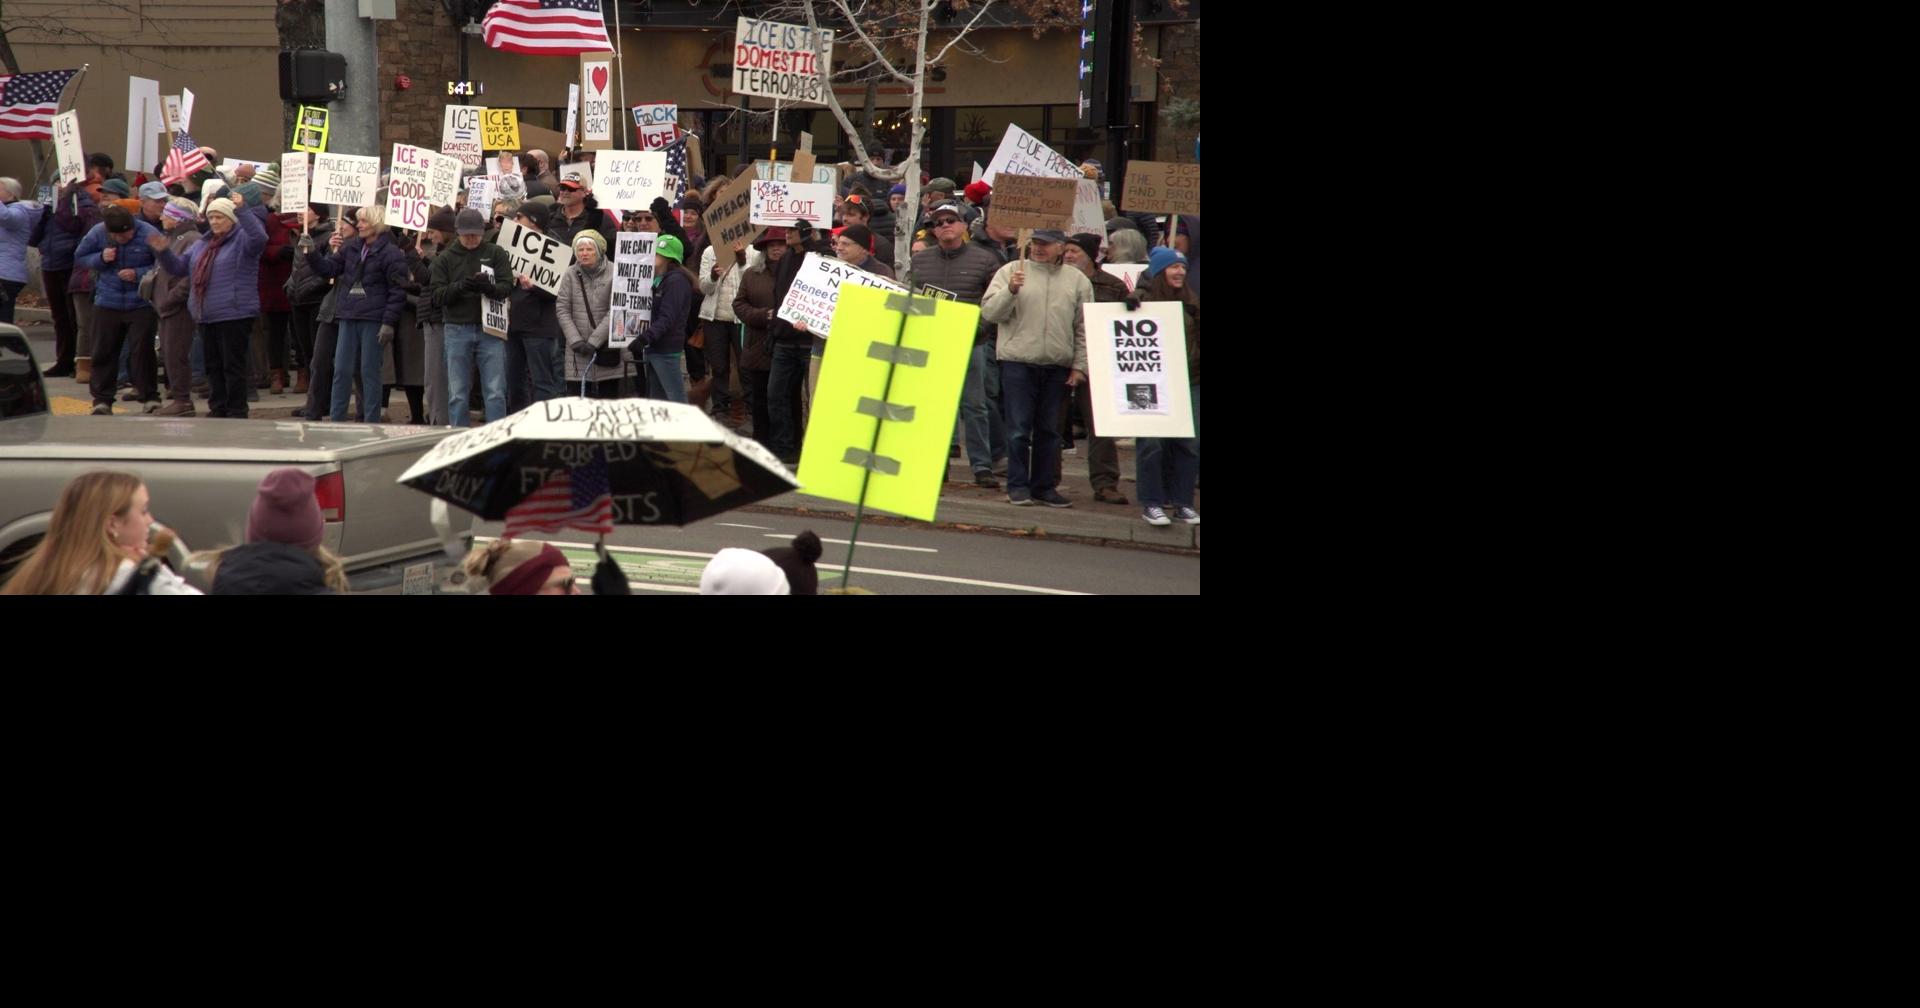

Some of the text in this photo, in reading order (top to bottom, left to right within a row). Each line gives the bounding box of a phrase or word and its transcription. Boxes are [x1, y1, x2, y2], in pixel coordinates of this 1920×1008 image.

[743, 20, 831, 52] ICE IS TE
[736, 44, 817, 74] DOMESTIC
[586, 100, 608, 116] DEMO
[452, 109, 478, 130] ICE
[485, 111, 510, 126] ICE
[585, 118, 609, 133] CRACY
[443, 142, 478, 153] DOMESTIC
[487, 134, 515, 147] USA
[643, 131, 674, 148] ICE
[1017, 132, 1045, 161] DUE
[396, 146, 416, 164] ICE
[319, 158, 378, 174] PROJECT 2025
[610, 159, 641, 173] DE-ICE
[328, 173, 361, 188] EQUALS
[471, 181, 486, 190] ICE
[603, 176, 620, 186] OUR
[626, 176, 652, 187] CITIES
[1128, 173, 1152, 186] THE
[324, 187, 365, 204] TYRANNY
[389, 179, 426, 201] GOOD
[1128, 185, 1156, 198] AND
[391, 199, 427, 228] IN US
[707, 190, 751, 227] IMPEACH
[766, 200, 815, 214] ICE OUT
[511, 225, 560, 264] ICE
[620, 240, 632, 254] WE
[529, 264, 561, 288] NOW
[617, 262, 653, 279] WAIT FOR
[819, 261, 854, 280] SAY
[626, 278, 639, 293] THE
[793, 279, 829, 298] Renee
[612, 292, 653, 311] MID-TERMS
[486, 312, 507, 331] ELVIS!
[1114, 319, 1158, 337] NO
[1115, 338, 1159, 348] FAUX
[1116, 350, 1161, 362] KING
[1117, 362, 1162, 373] WAY!
